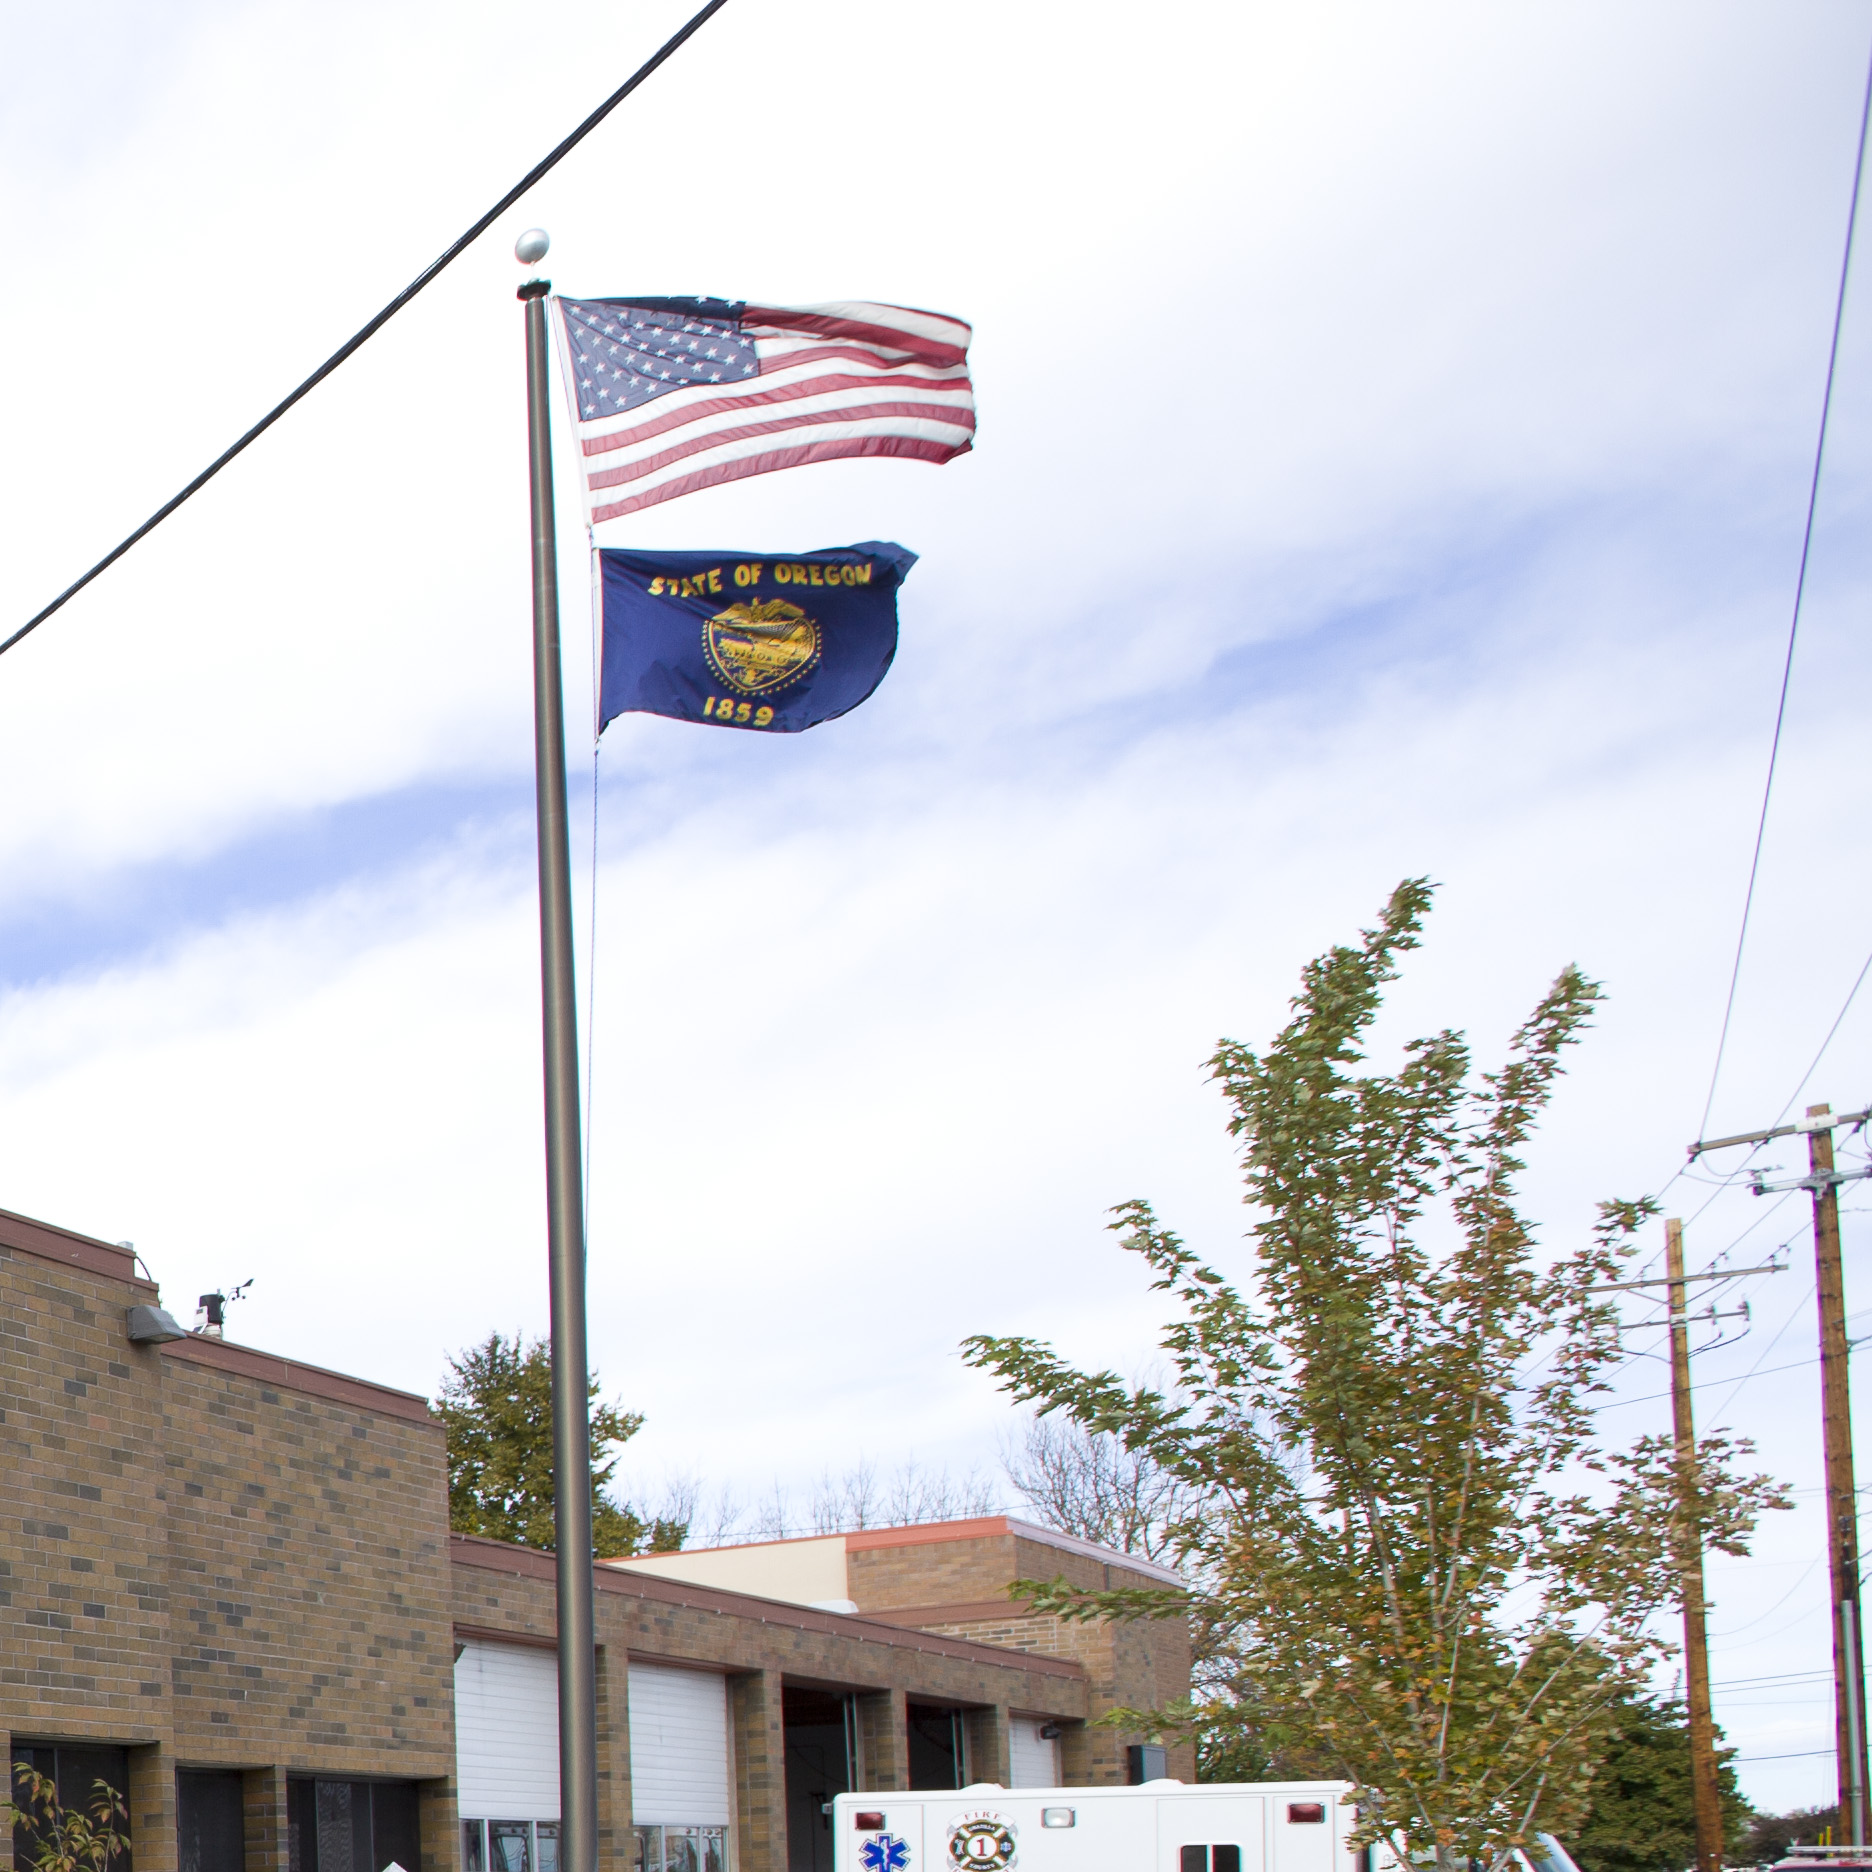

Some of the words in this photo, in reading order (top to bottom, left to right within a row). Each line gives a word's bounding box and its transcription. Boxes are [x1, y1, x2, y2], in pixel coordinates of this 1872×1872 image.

[647, 568, 722, 598] STATE
[734, 563, 763, 588] OF
[774, 562, 874, 587] OREGON
[703, 696, 774, 726] 1859
[977, 1837, 987, 1857] 1
